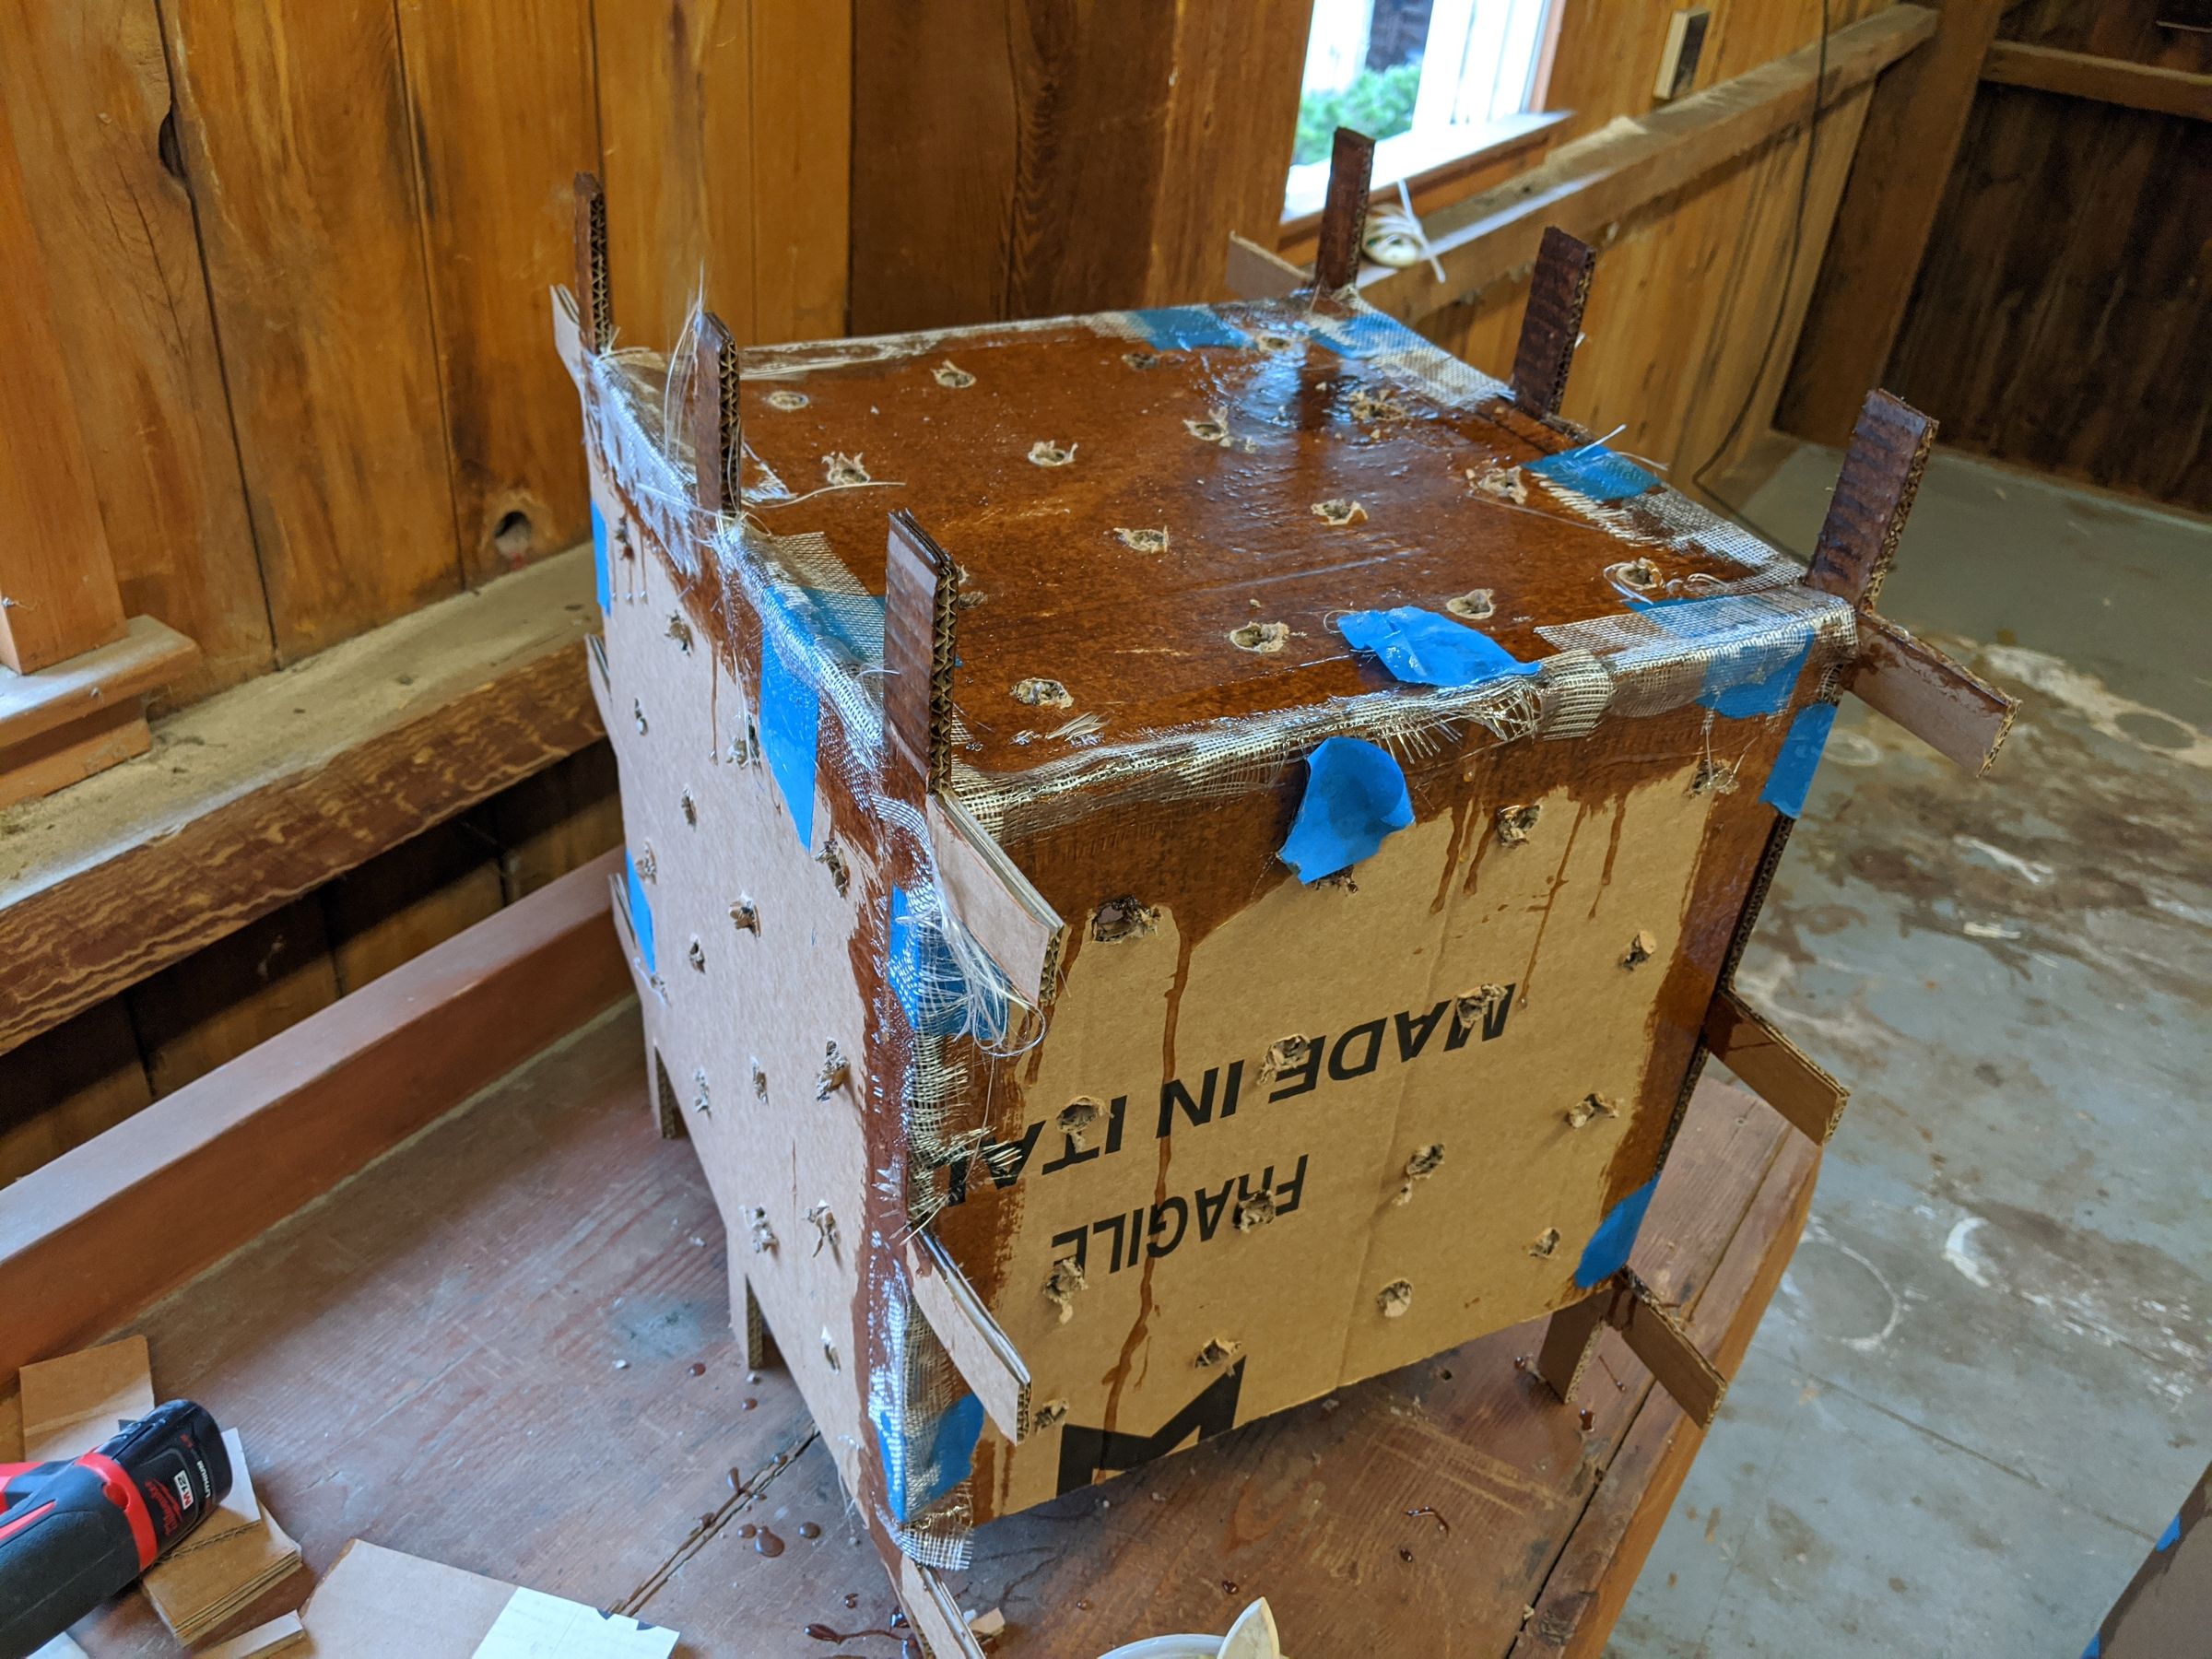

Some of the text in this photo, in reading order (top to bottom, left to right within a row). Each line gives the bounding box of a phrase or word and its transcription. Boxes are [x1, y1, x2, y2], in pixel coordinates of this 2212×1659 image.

[929, 982, 1516, 1207] MADE IN ITAL
[177, 1475, 192, 1506] M12
